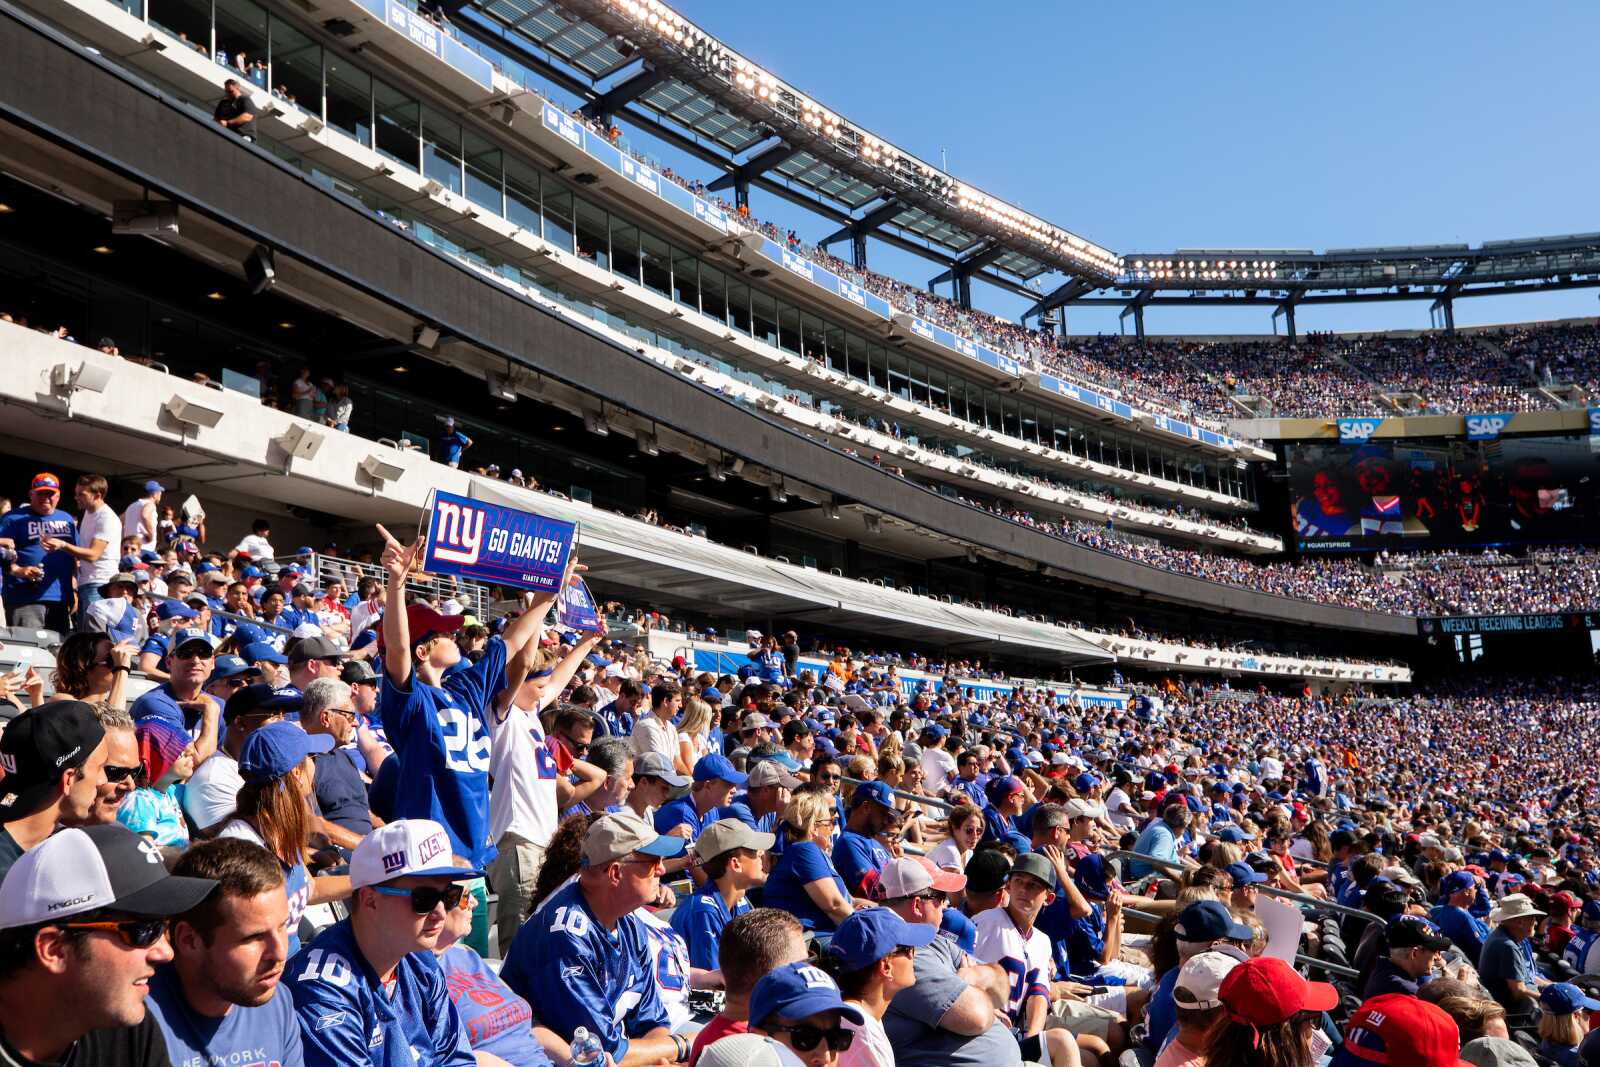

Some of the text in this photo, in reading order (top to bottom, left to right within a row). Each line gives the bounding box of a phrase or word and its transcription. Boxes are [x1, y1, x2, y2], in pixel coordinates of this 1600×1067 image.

[1339, 422, 1375, 440] SAP
[1467, 418, 1504, 436] SAP
[28, 521, 72, 536] GIANTS
[488, 527, 563, 564] GO GIANTS!
[522, 574, 539, 583] GIANTS
[1441, 618, 1476, 632] WEEKLY
[1479, 617, 1523, 632] RECEIVING
[1524, 616, 1563, 629] LEADERS
[56, 746, 81, 767] Giants
[550, 906, 588, 936] 10
[298, 948, 351, 987] 10
[219, 1047, 267, 1067] YORK
